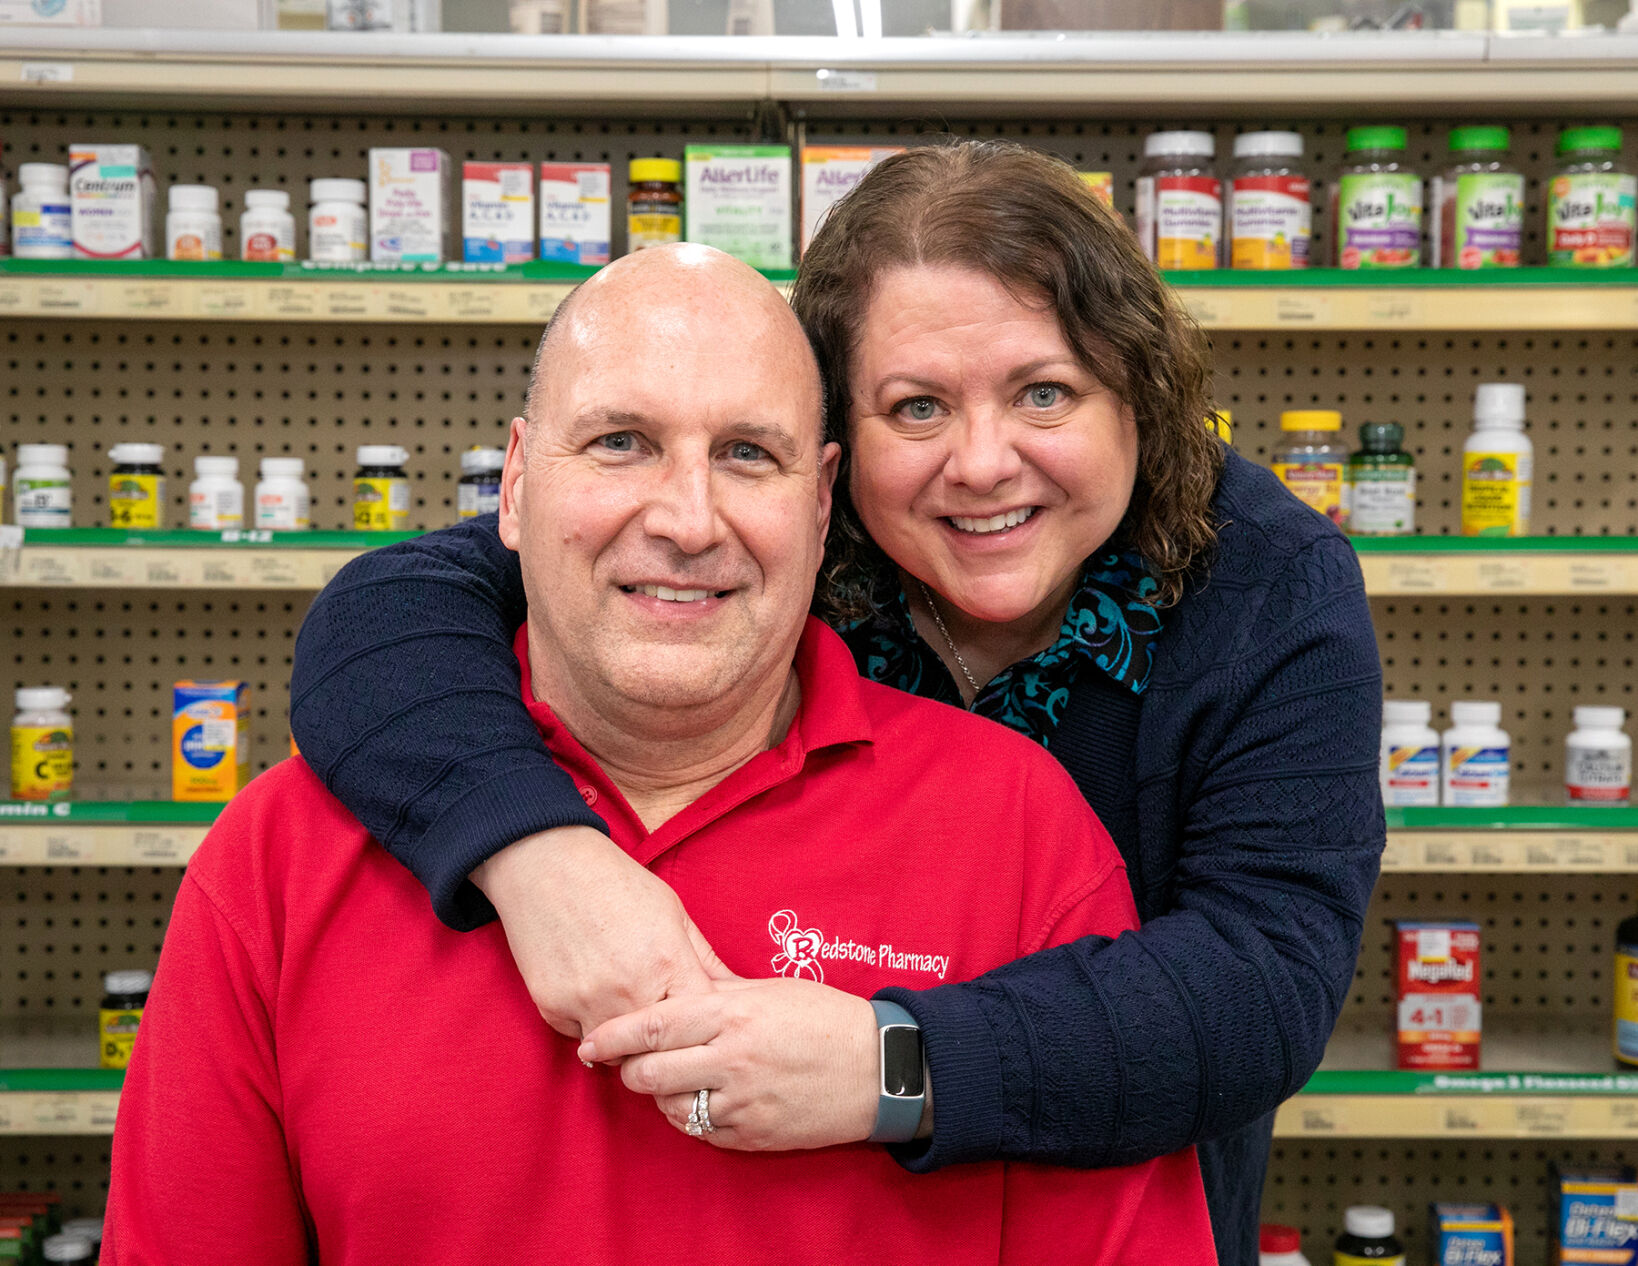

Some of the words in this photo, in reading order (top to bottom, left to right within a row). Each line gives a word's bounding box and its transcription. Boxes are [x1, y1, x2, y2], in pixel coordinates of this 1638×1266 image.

[700, 165, 780, 184] AllerLife
[75, 178, 136, 193] Centrum
[35, 760, 49, 780] C
[52, 801, 72, 817] C
[879, 944, 950, 980] Pharmacy
[1407, 958, 1474, 983] MegaRed
[1434, 1075, 1505, 1091] Omega
[1507, 1075, 1520, 1090] 3
